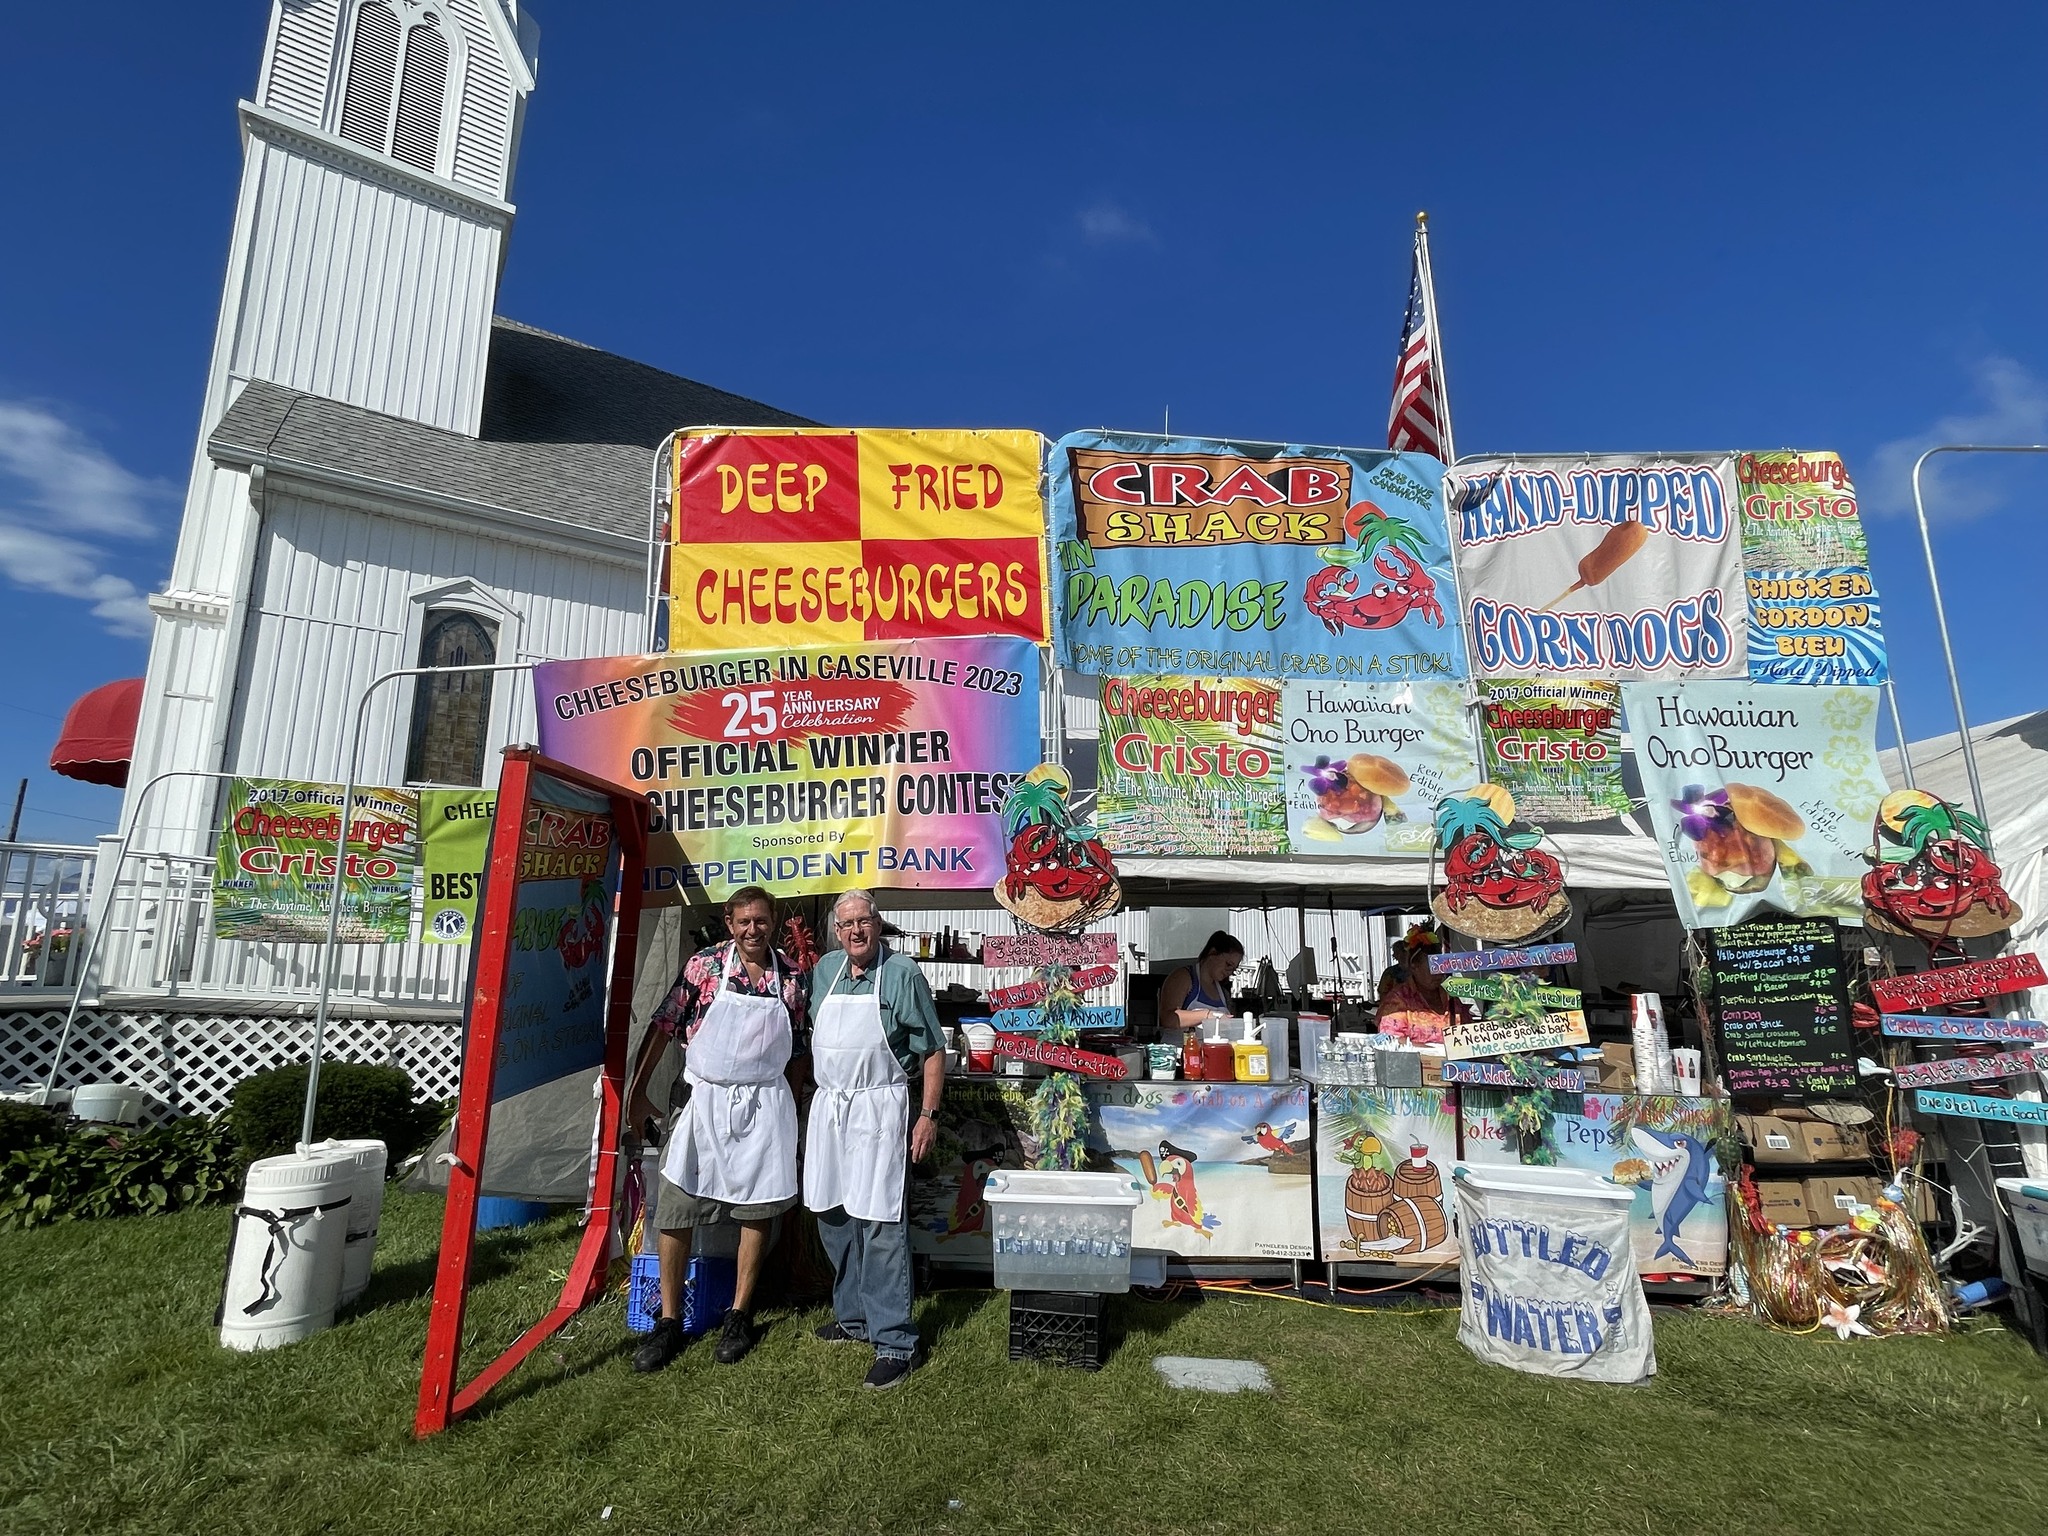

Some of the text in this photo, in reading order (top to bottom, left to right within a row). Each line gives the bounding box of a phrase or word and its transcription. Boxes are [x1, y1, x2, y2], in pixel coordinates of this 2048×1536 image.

[717, 462, 1004, 516] DEEP FRIED
[1089, 462, 1342, 506] CRAB
[1380, 467, 1407, 485] CRAB
[1459, 465, 1731, 549] HAND-DIPPED
[1745, 493, 1858, 520] Cristo
[1106, 511, 1331, 543] SHACK
[1057, 539, 1096, 572] IN
[696, 561, 1029, 625] CHEESEBURGERS
[1747, 574, 1872, 599] CHICKEN
[1067, 571, 1288, 632] PARADISE
[1756, 604, 1869, 628] CORDON
[1470, 588, 1731, 673] CORN DOGS
[1775, 636, 1845, 657] BLEU
[1117, 644, 1143, 669] OF
[1146, 645, 1183, 669] THE
[1186, 649, 1278, 677] ORIGINAL
[1280, 651, 1333, 675] CRAB
[1335, 655, 1363, 675] ON
[1367, 653, 1383, 675] A
[1386, 652, 1453, 675] STICK!
[1754, 661, 1880, 680] Hand Dipped
[554, 653, 1024, 721] CHEESEBURGER IN CASEVILLE 2023
[782, 690, 813, 701] YEAR
[1490, 686, 1615, 702] 2017 Official Winner
[721, 690, 778, 738] 25
[782, 697, 881, 715] ANNIVERSARY
[1104, 678, 1280, 736] Cheeseburger
[1306, 690, 1411, 714] Hawaiian
[1657, 695, 1799, 728] Hawaiian
[781, 712, 875, 729] Celebration
[1487, 704, 1615, 737] Cheeseburger
[1290, 718, 1424, 752] Ono Burger
[631, 730, 952, 781] OFFICIAL WINNER
[1114, 732, 1272, 779] Cristo
[1496, 736, 1608, 762] Cristo
[1707, 734, 1813, 782] Burger
[1410, 773, 1444, 795] Edible
[1416, 763, 1443, 780] Real
[1123, 777, 1142, 797] The
[249, 789, 408, 815] 2017 Officia Winner
[644, 773, 1026, 834] CHEESEBURGER CONTES
[1813, 799, 1845, 822] Real
[524, 808, 610, 849] CRAB
[1799, 801, 1837, 832] Edible
[752, 830, 845, 849] Sponsored By
[1810, 821, 1863, 862] Orchid!
[238, 846, 398, 880] Cristo
[520, 851, 601, 878] SHACK
[643, 846, 975, 891] DEPENDENT BANK
[249, 896, 269, 910] The
[996, 948, 1006, 959] 3
[1485, 949, 1498, 968] I
[1753, 958, 1784, 970] Bacon
[1000, 1010, 1021, 1029] We
[1547, 1020, 1574, 1035] back
[1123, 1084, 1164, 1110] dogs
[1192, 1089, 1225, 1109] Crab
[1945, 1096, 1981, 1115] Shell
[1982, 1101, 1998, 1117] of
[1464, 1118, 1616, 1152] oke Peps
[1487, 1287, 1603, 1354] WATER
